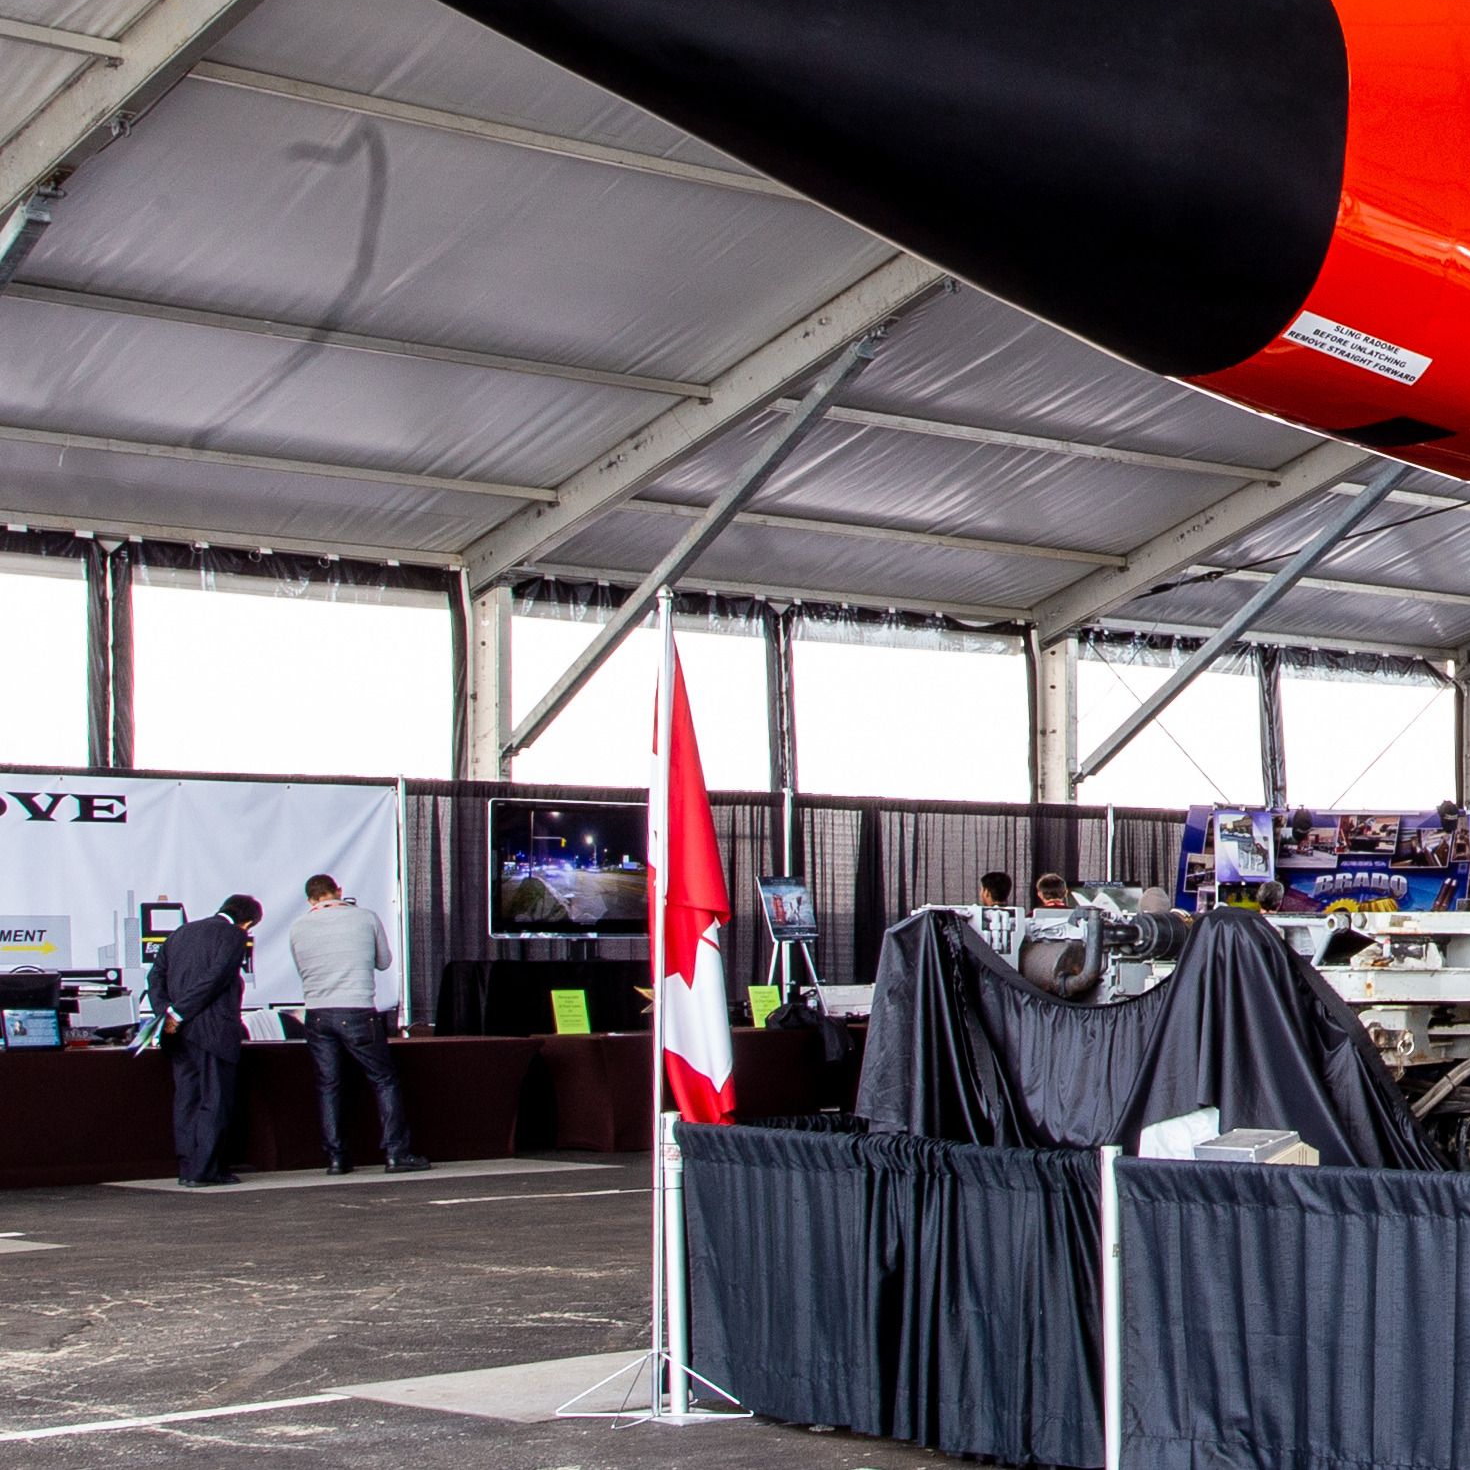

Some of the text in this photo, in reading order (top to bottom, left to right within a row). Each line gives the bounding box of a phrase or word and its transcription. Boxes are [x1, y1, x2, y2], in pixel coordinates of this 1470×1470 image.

[1312, 328, 1408, 369] BEFORE UNLATCHING
[1333, 324, 1401, 355] SLING RADOME
[1287, 330, 1416, 383] REMOVE STRAIGHT FORWARD
[0, 792, 127, 823] VE
[1313, 871, 1408, 899] BRADO
